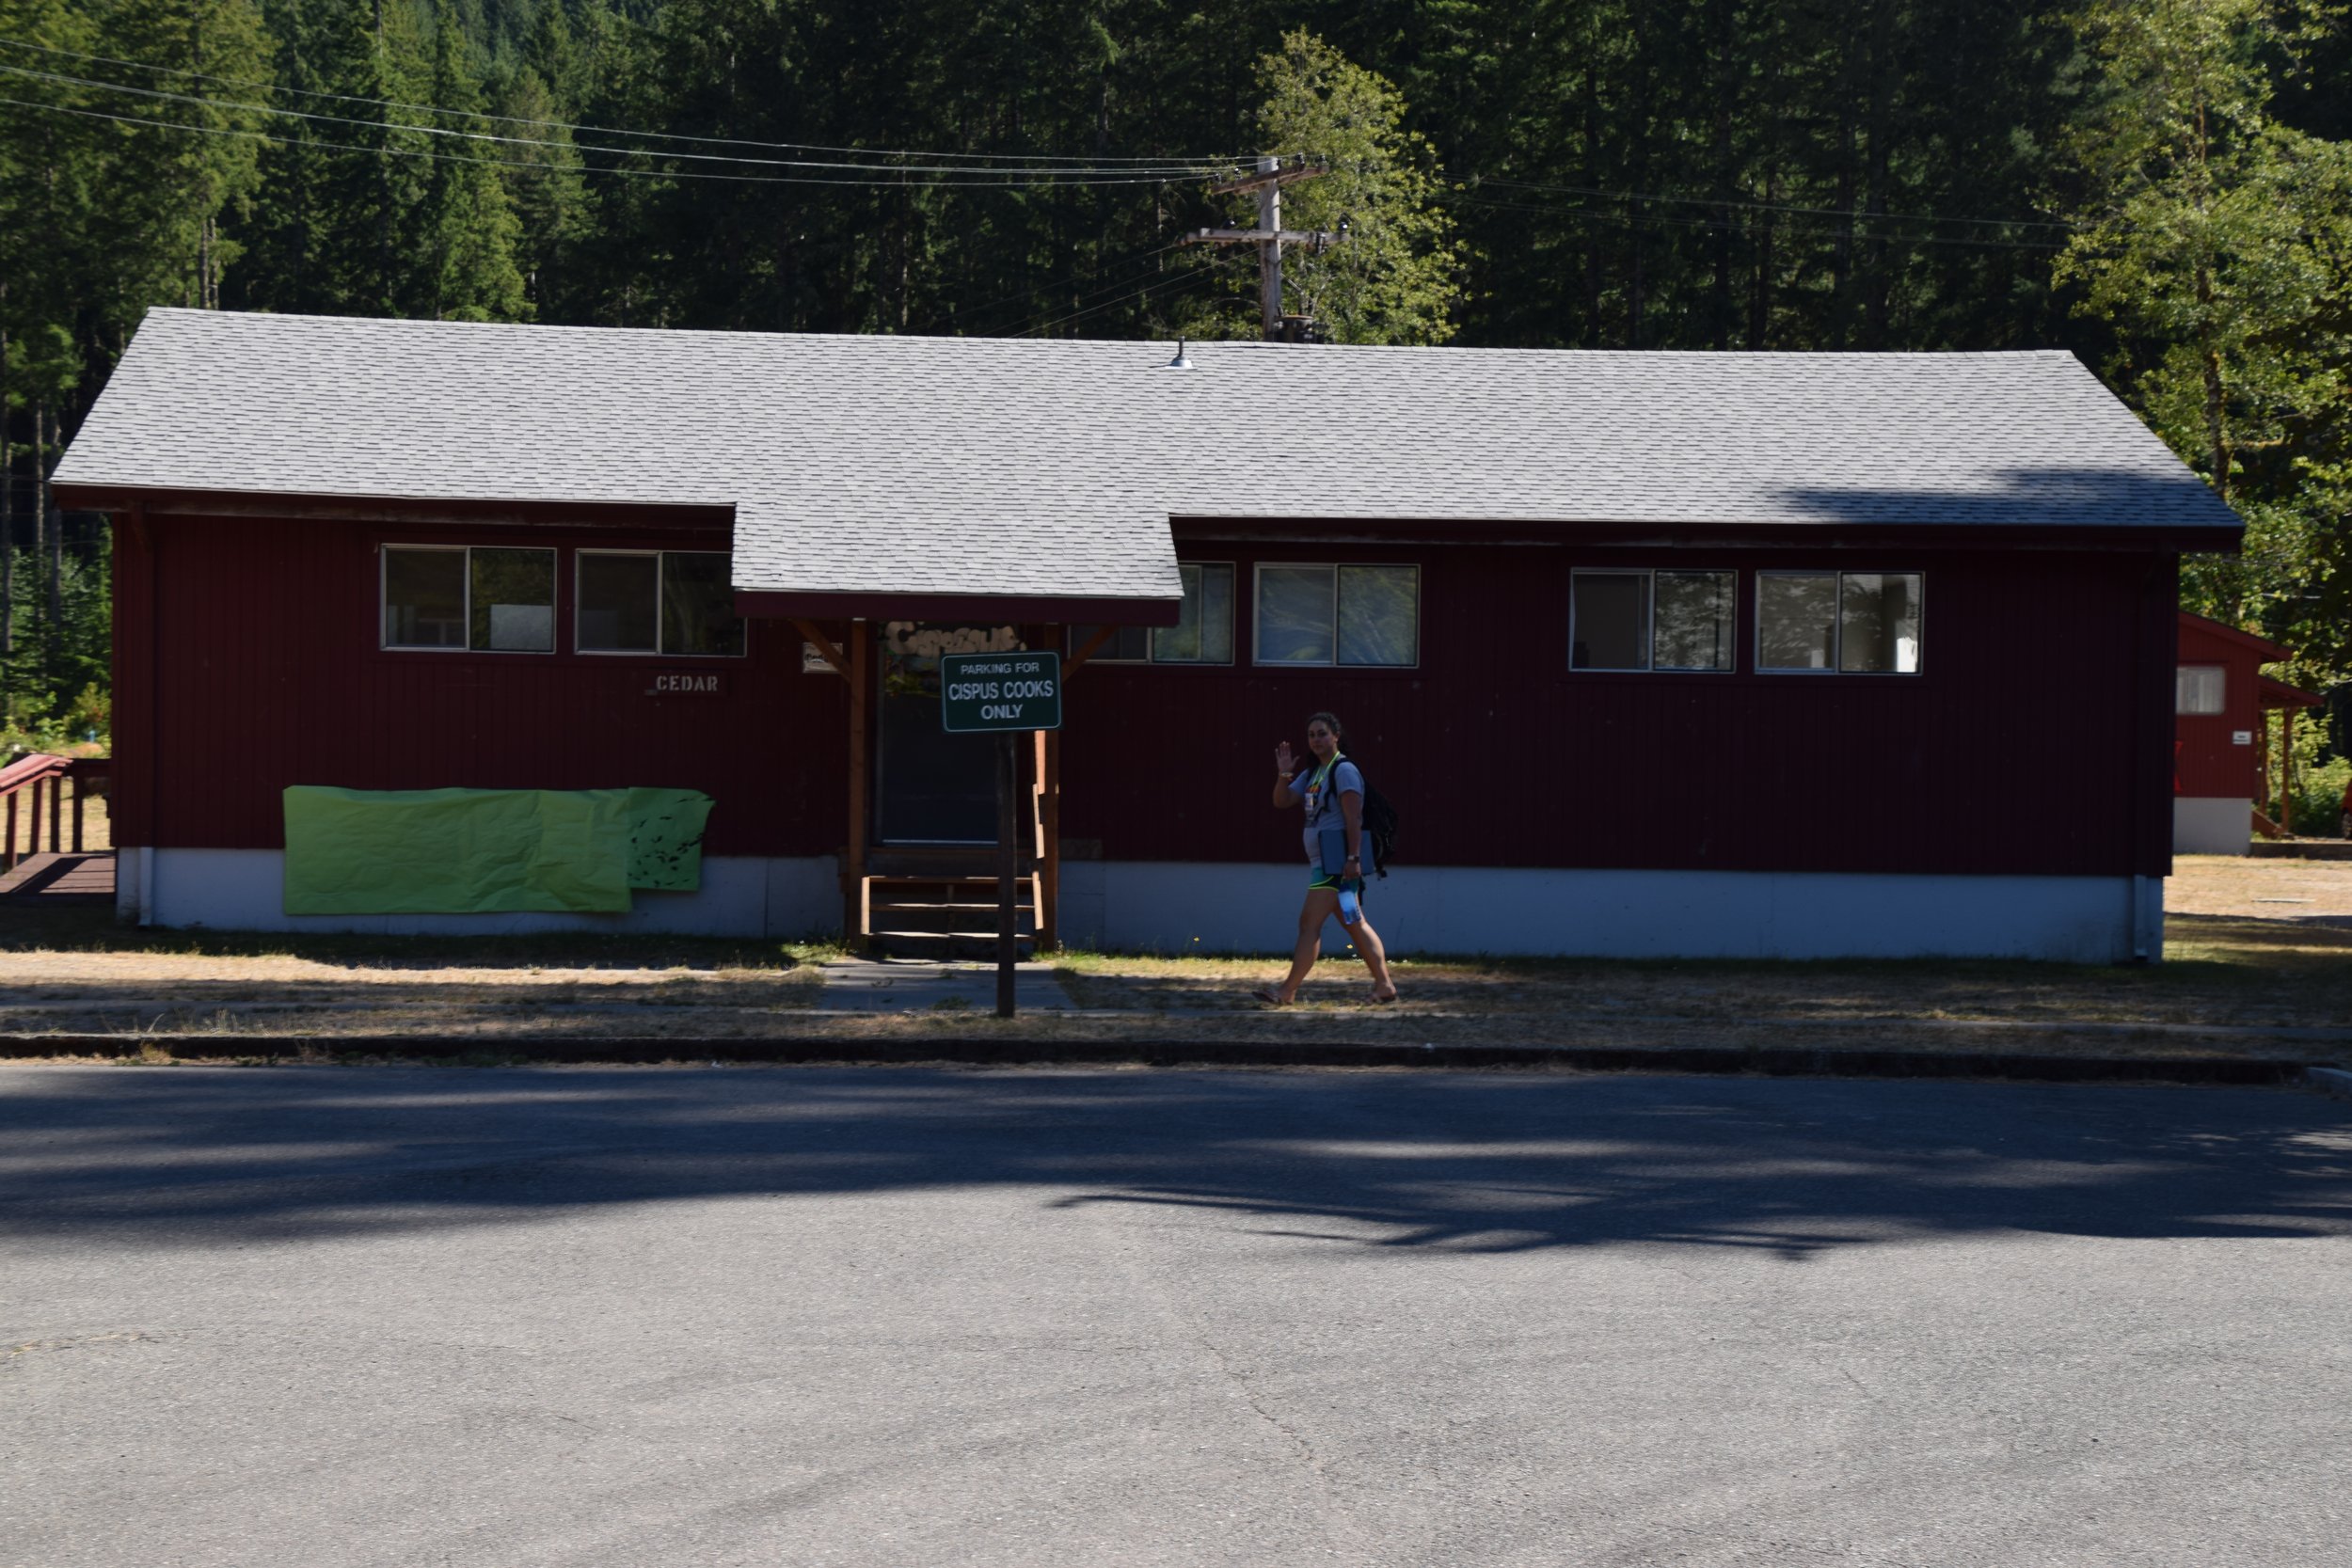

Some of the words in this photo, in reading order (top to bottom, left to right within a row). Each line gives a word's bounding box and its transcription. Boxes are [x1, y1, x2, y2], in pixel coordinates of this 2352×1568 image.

[961, 663, 1012, 674] PARKING
[1015, 662, 1040, 673] FOR
[656, 675, 718, 691] CEDAR
[948, 682, 999, 701] CISPUS
[1003, 680, 1054, 699] COOKS
[980, 704, 1024, 720] ONLY
